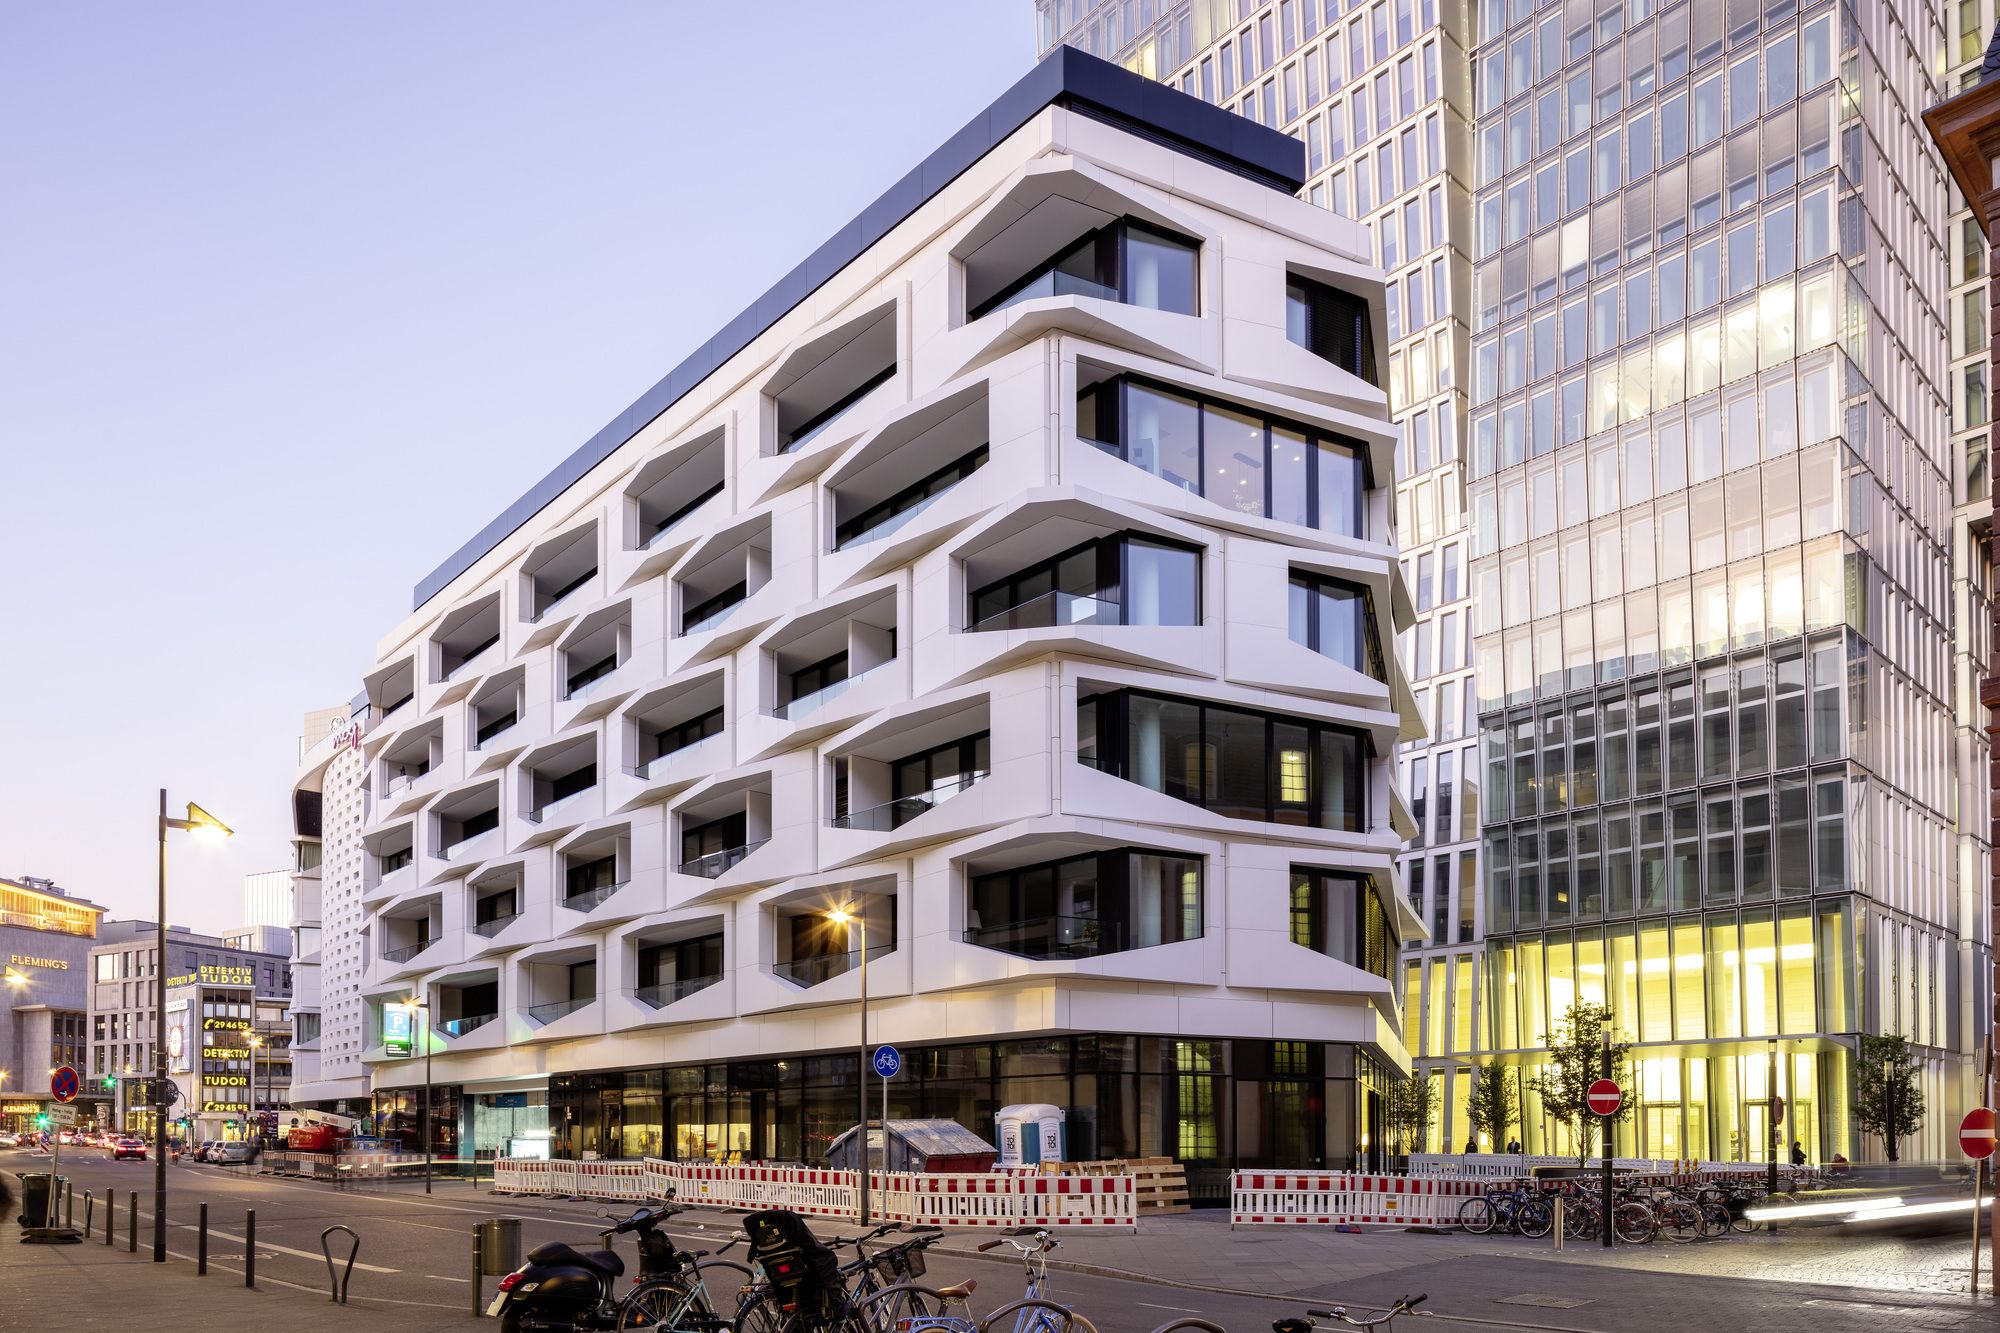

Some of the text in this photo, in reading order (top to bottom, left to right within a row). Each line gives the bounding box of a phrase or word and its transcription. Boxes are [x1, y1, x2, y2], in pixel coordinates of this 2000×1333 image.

[10, 954, 68, 970] FLEMING'S
[200, 965, 252, 976] DETEKTIV
[200, 974, 252, 985] TUDOR
[204, 1076, 247, 1086] TUDOR
[2, 1104, 40, 1113] FLEMING'S
